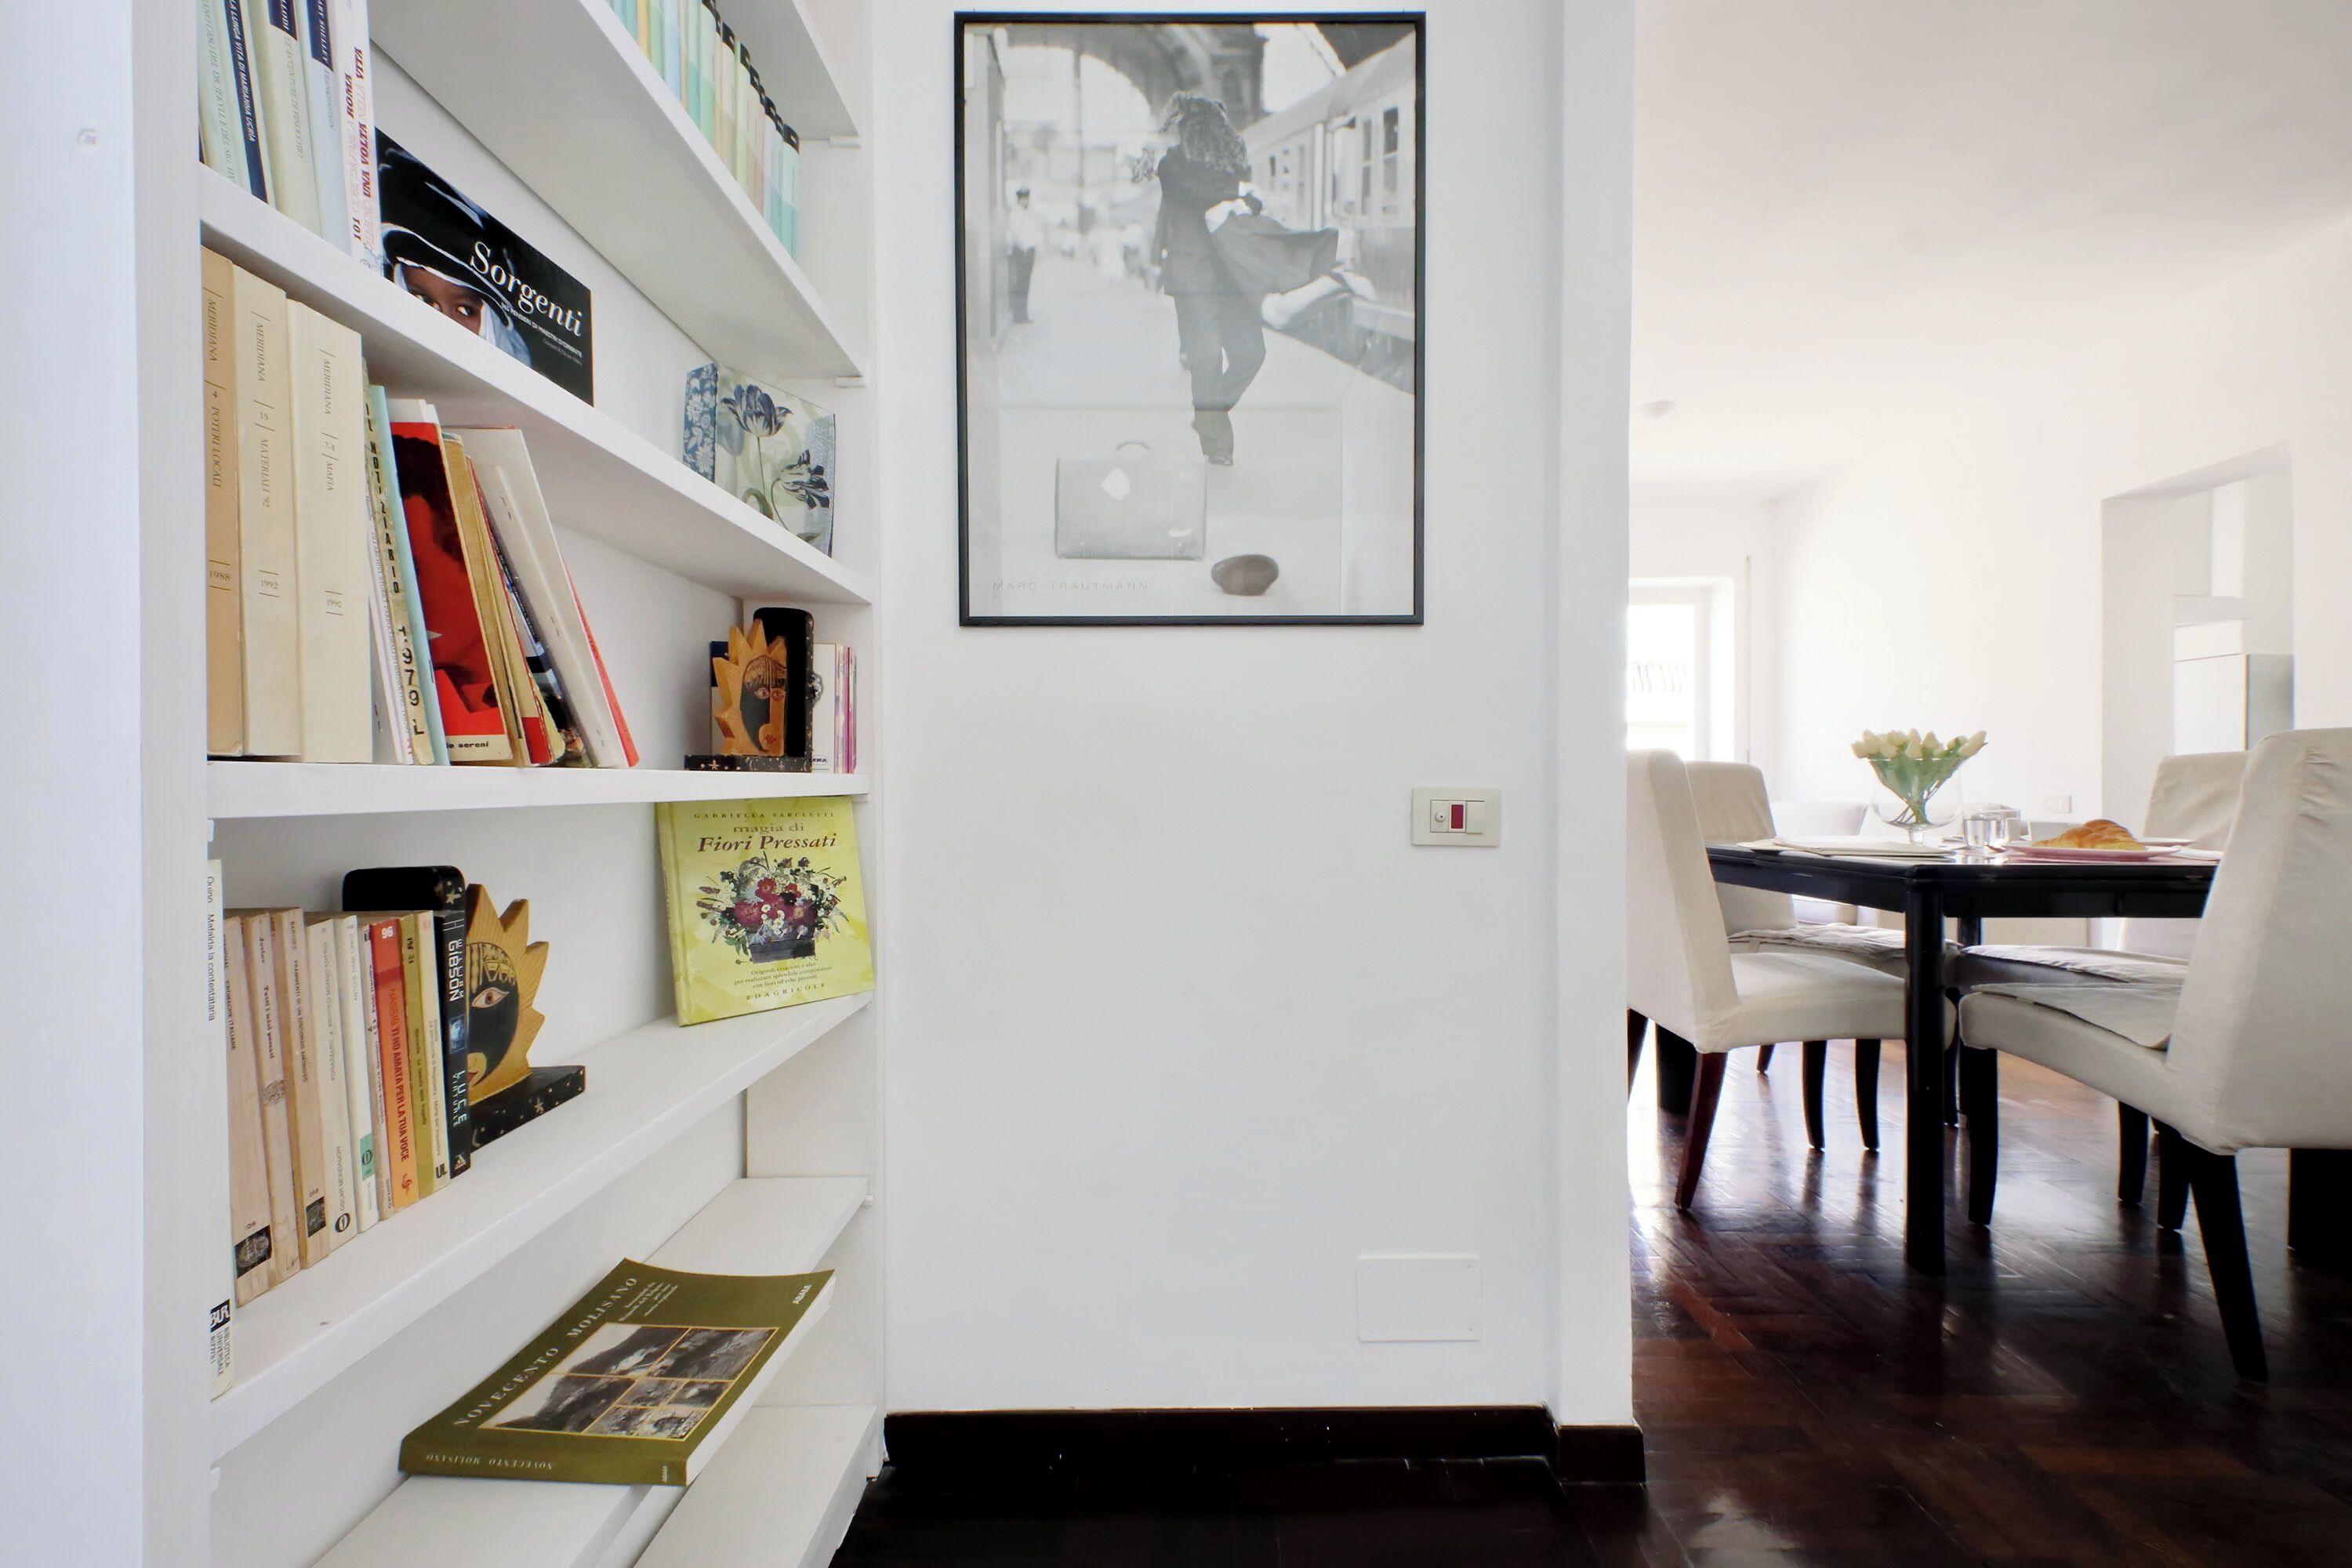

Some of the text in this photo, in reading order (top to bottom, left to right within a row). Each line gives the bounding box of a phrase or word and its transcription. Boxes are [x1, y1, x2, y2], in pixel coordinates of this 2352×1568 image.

[230, 12, 243, 39] LUNGA
[235, 41, 246, 61] VITA
[354, 46, 365, 79] VITA
[238, 62, 247, 71] DI
[238, 72, 252, 116] MARIANNA
[344, 72, 354, 119] ROMA
[358, 122, 369, 165] VOLTA
[361, 169, 372, 198] UNA
[351, 217, 362, 242] 101
[470, 241, 583, 336] Sorgenti
[207, 299, 220, 362] MERIDIANA
[256, 321, 267, 382] MERIDIANA
[323, 358, 332, 415] MERIDIANA
[211, 405, 222, 488] POTERI LOCALI
[260, 438, 270, 493] MATERIALI
[325, 461, 335, 491] MAFIA
[209, 571, 230, 582] 1988
[260, 579, 278, 590] 1992
[993, 582, 1149, 590] MARC TRAUTMANN
[733, 822, 804, 834] magia di
[697, 833, 837, 852] Fiori Pressati
[381, 926, 394, 939] 96
[207, 952, 215, 960] la
[448, 941, 459, 1002] GIBSON
[207, 963, 216, 1022] contestataria
[746, 982, 826, 1000] EDAGRICOLE
[393, 1052, 405, 1084] AMATA
[395, 1085, 406, 1104] PER
[457, 1069, 468, 1125] LUCE
[397, 1104, 407, 1118] LA
[397, 1118, 408, 1137] TUA
[399, 1138, 410, 1162] VOCE
[210, 1303, 230, 1330] BUR
[452, 1346, 560, 1427] NOVECENTO
[566, 1276, 638, 1340] MOLISANO
[425, 1454, 553, 1471] NOVECENTO MOLISANO
